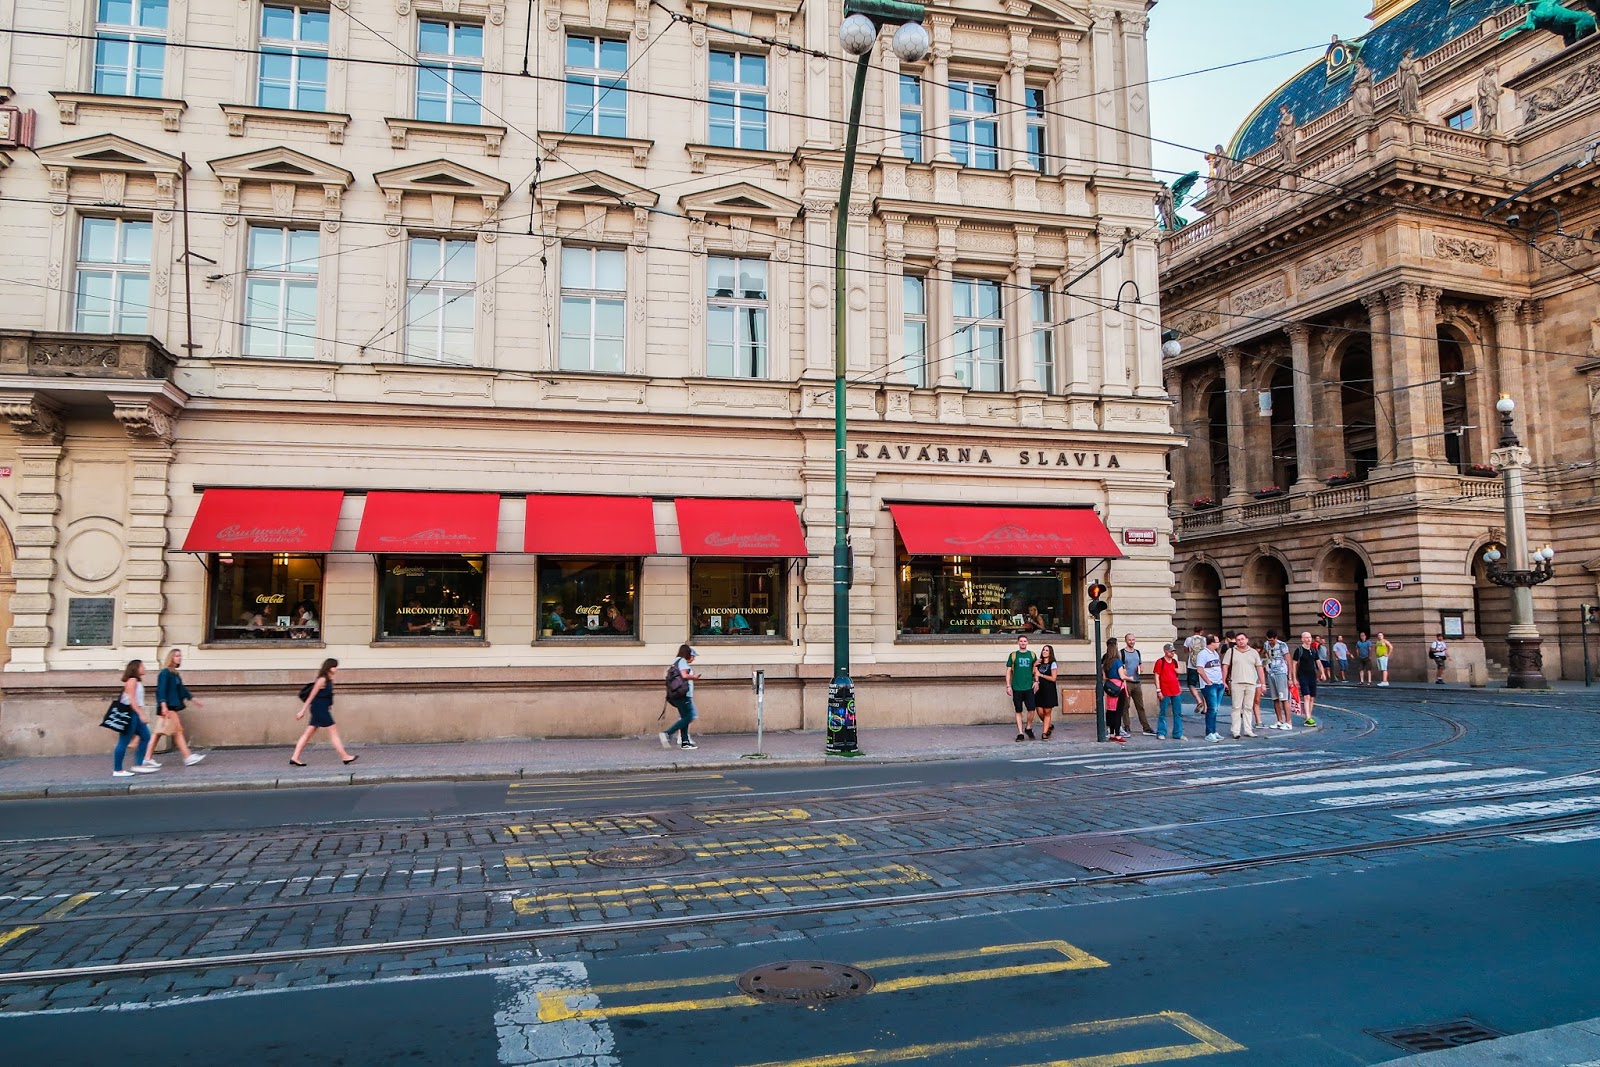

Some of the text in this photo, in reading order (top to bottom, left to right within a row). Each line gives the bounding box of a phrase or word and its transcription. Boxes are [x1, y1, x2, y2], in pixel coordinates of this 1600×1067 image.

[856, 443, 1121, 469] KAVÁRNA SLAVIA
[256, 594, 286, 603] Coca-Cola
[396, 607, 470, 615] AIRCONDITIONED
[575, 605, 602, 614] Coca-Cola
[702, 607, 769, 615] AIRCONDITIONED
